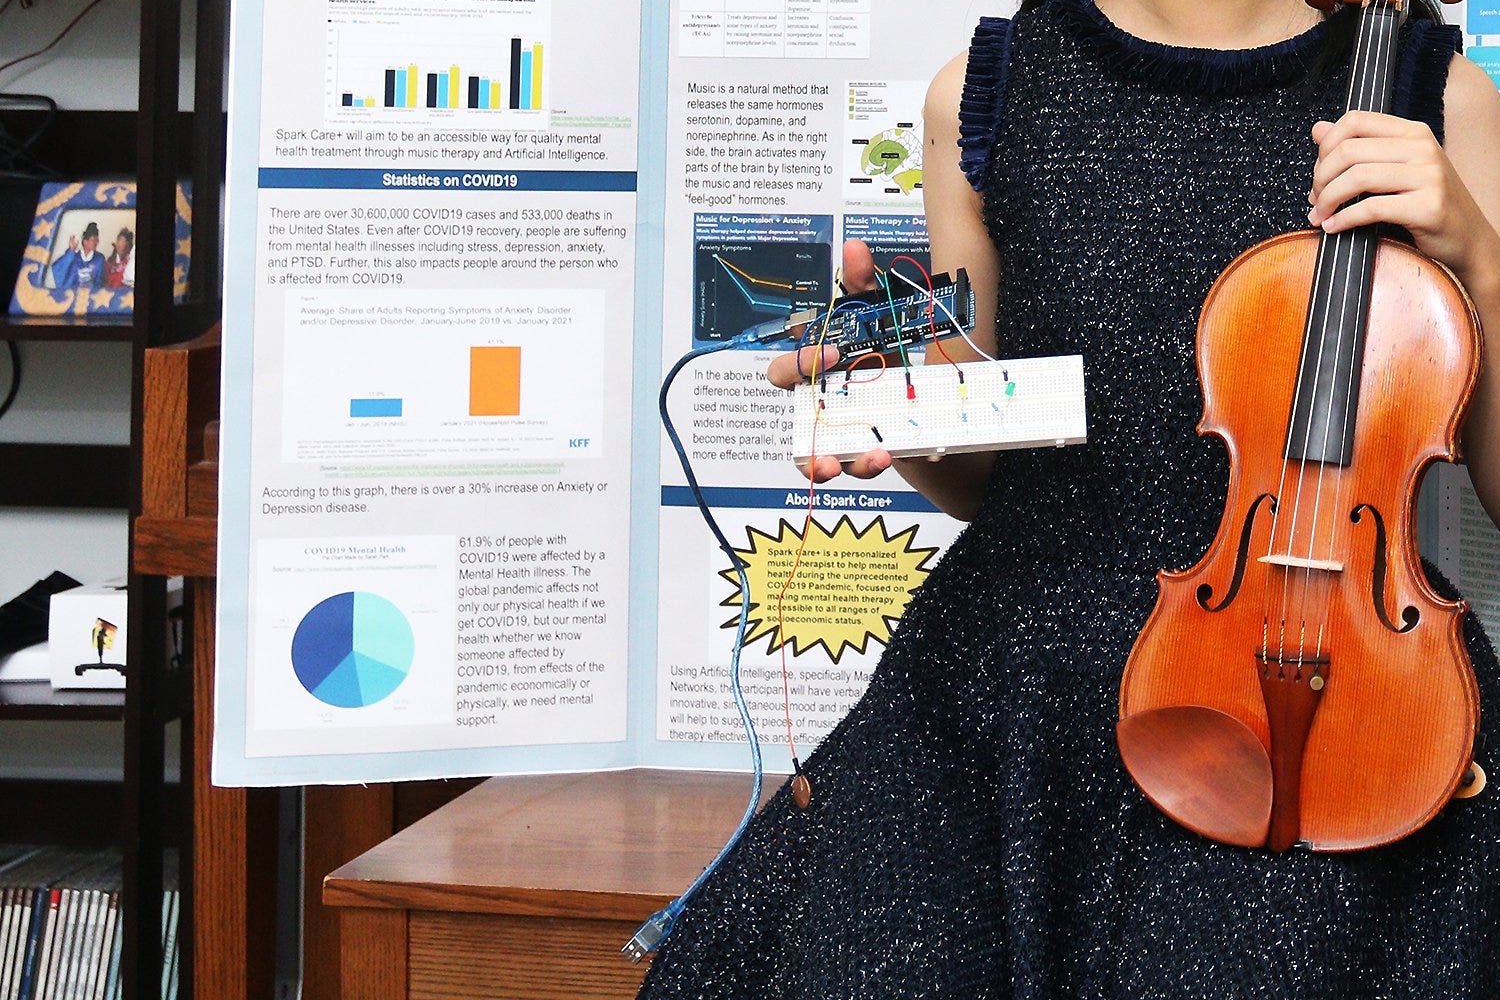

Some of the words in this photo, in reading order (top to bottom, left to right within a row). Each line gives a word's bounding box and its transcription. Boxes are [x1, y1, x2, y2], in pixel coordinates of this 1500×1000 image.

[688, 82, 715, 93] Music
[737, 84, 769, 94] natural
[772, 84, 807, 94] method
[810, 84, 828, 94] that
[382, 173, 440, 186] Statistics
[443, 176, 459, 186] on
[462, 174, 517, 186] COVID19
[270, 207, 300, 218] There
[304, 210, 320, 218] are
[324, 210, 347, 218] over
[350, 208, 409, 219] 30,600,000
[412, 208, 462, 219] COVID19
[466, 211, 495, 219] cases
[499, 209, 518, 219] and
[522, 209, 563, 220] 533,000
[566, 209, 600, 220] deaths
[604, 210, 612, 219] in
[696, 215, 718, 223] Music
[732, 216, 773, 224] Depression
[783, 217, 811, 226] Anxiety
[569, 438, 589, 447] KFF
[785, 493, 820, 506] About
[823, 494, 855, 508] Spark
[859, 495, 892, 508] Care+
[459, 536, 492, 547] 61.9%
[495, 535, 505, 546] of
[508, 535, 542, 548] people
[546, 534, 566, 544] with
[841, 550, 896, 558] personalized
